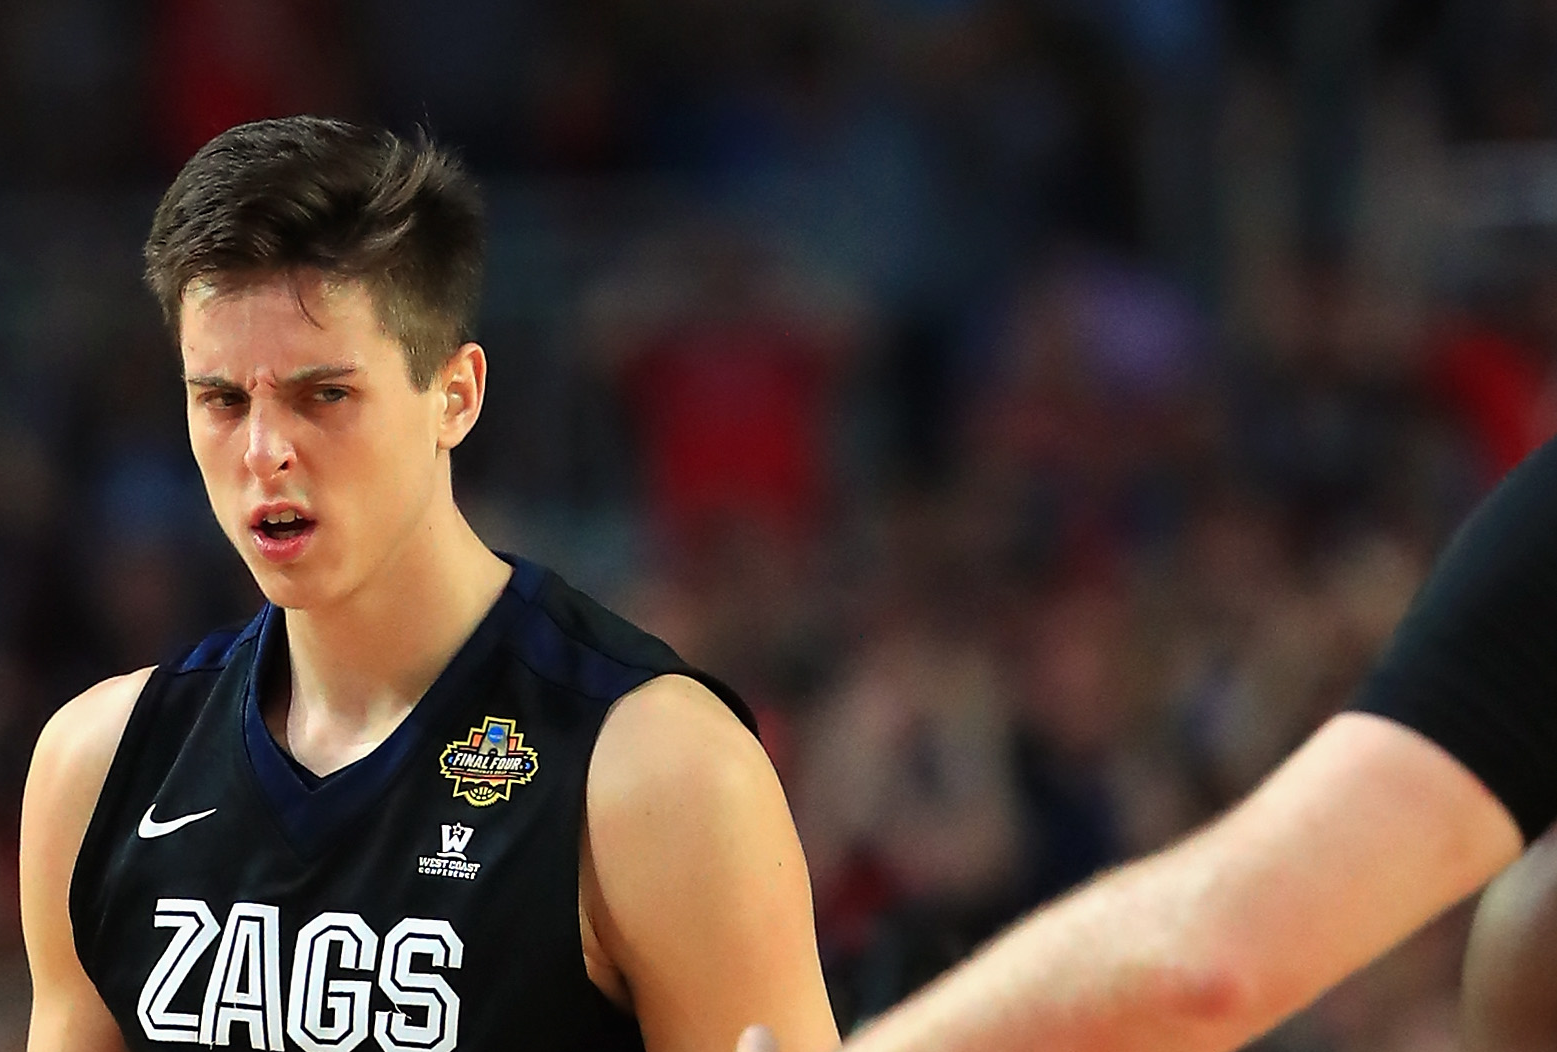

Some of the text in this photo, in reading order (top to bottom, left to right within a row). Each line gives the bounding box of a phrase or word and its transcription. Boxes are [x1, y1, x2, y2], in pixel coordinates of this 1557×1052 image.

[452, 752, 522, 771] FINAL FOUR
[418, 856, 481, 873] WEST COAST
[418, 866, 476, 880] CONFERENCE
